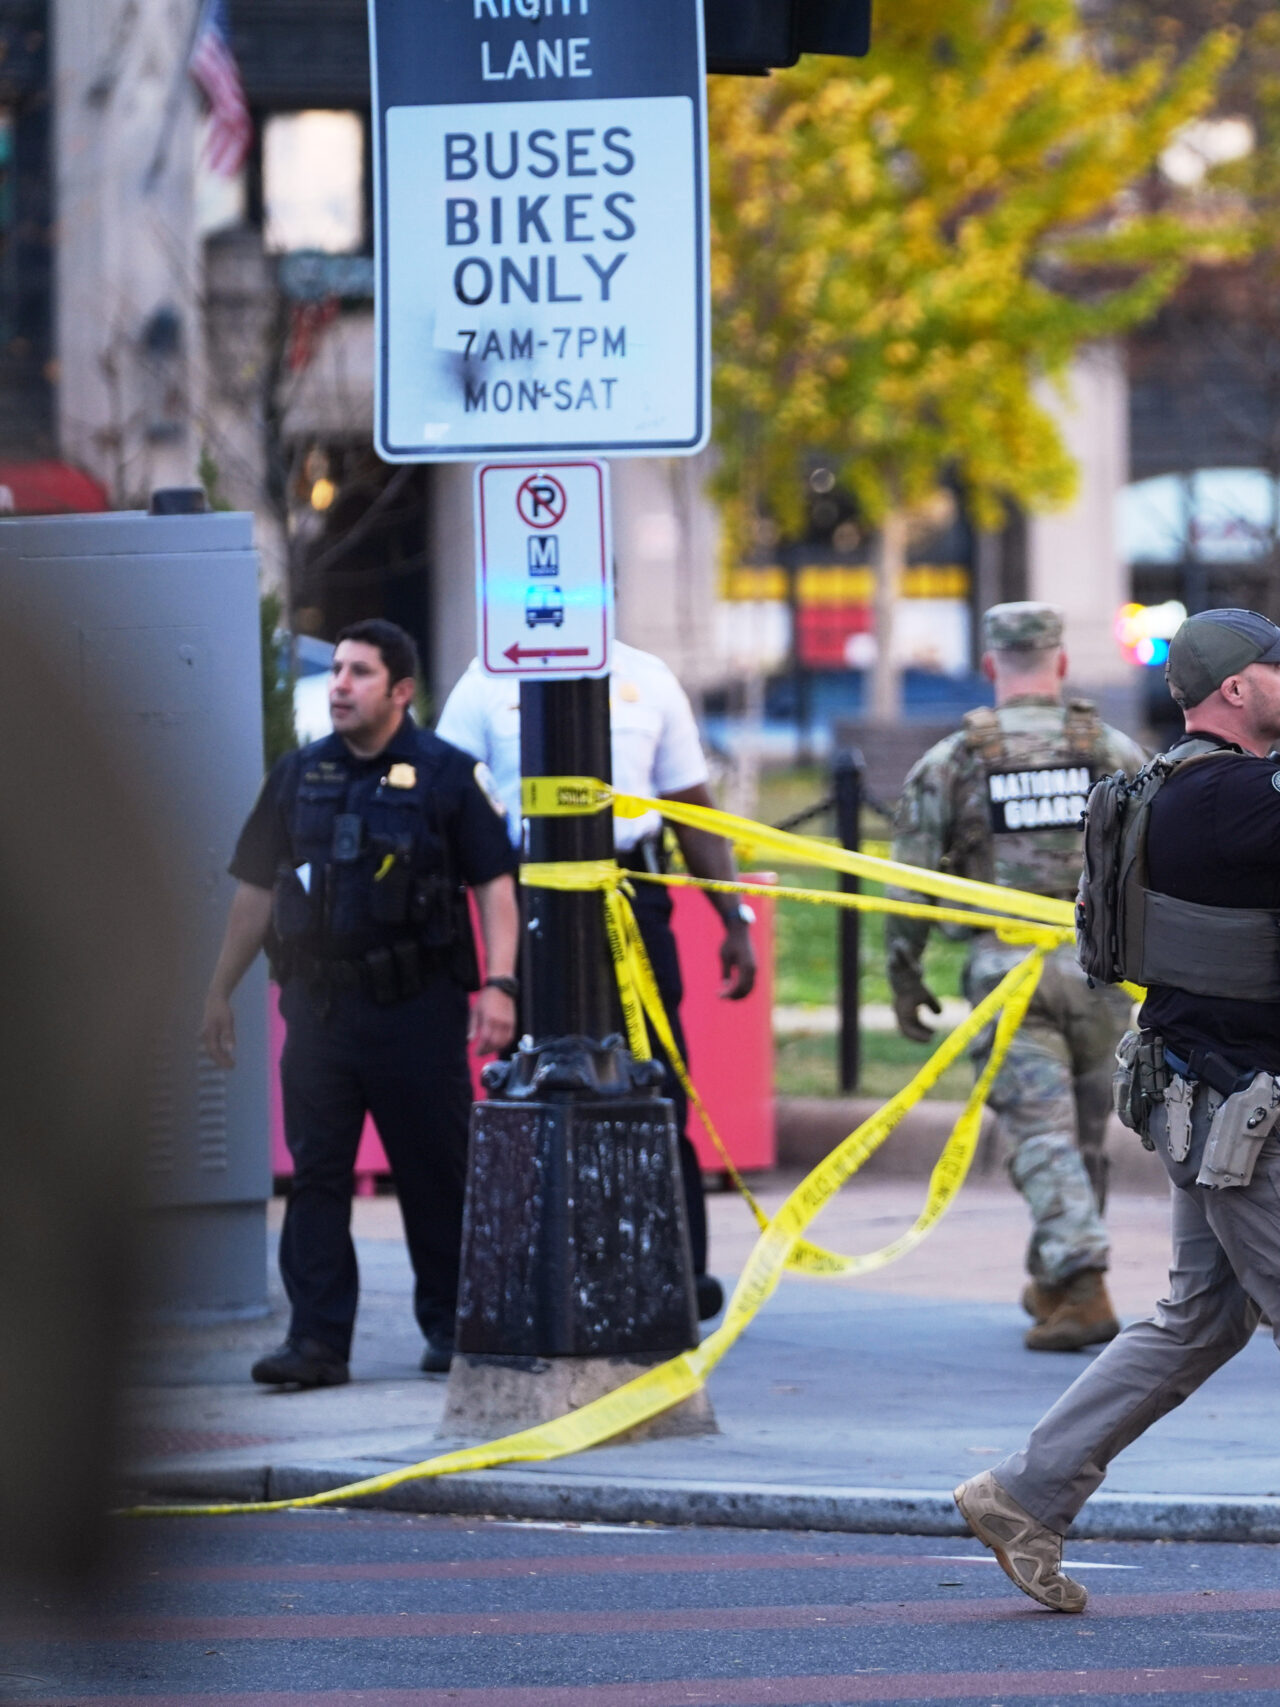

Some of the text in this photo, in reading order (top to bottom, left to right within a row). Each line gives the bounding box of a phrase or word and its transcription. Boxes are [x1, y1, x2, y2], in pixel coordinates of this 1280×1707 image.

[481, 37, 593, 81] LANE
[444, 126, 636, 181] BUSES
[445, 191, 637, 246] BIKES
[453, 252, 629, 306] ONLY
[457, 325, 627, 362] 7AM-7PM
[463, 376, 618, 413] MON-SAT
[989, 767, 1091, 803] NATIONAL
